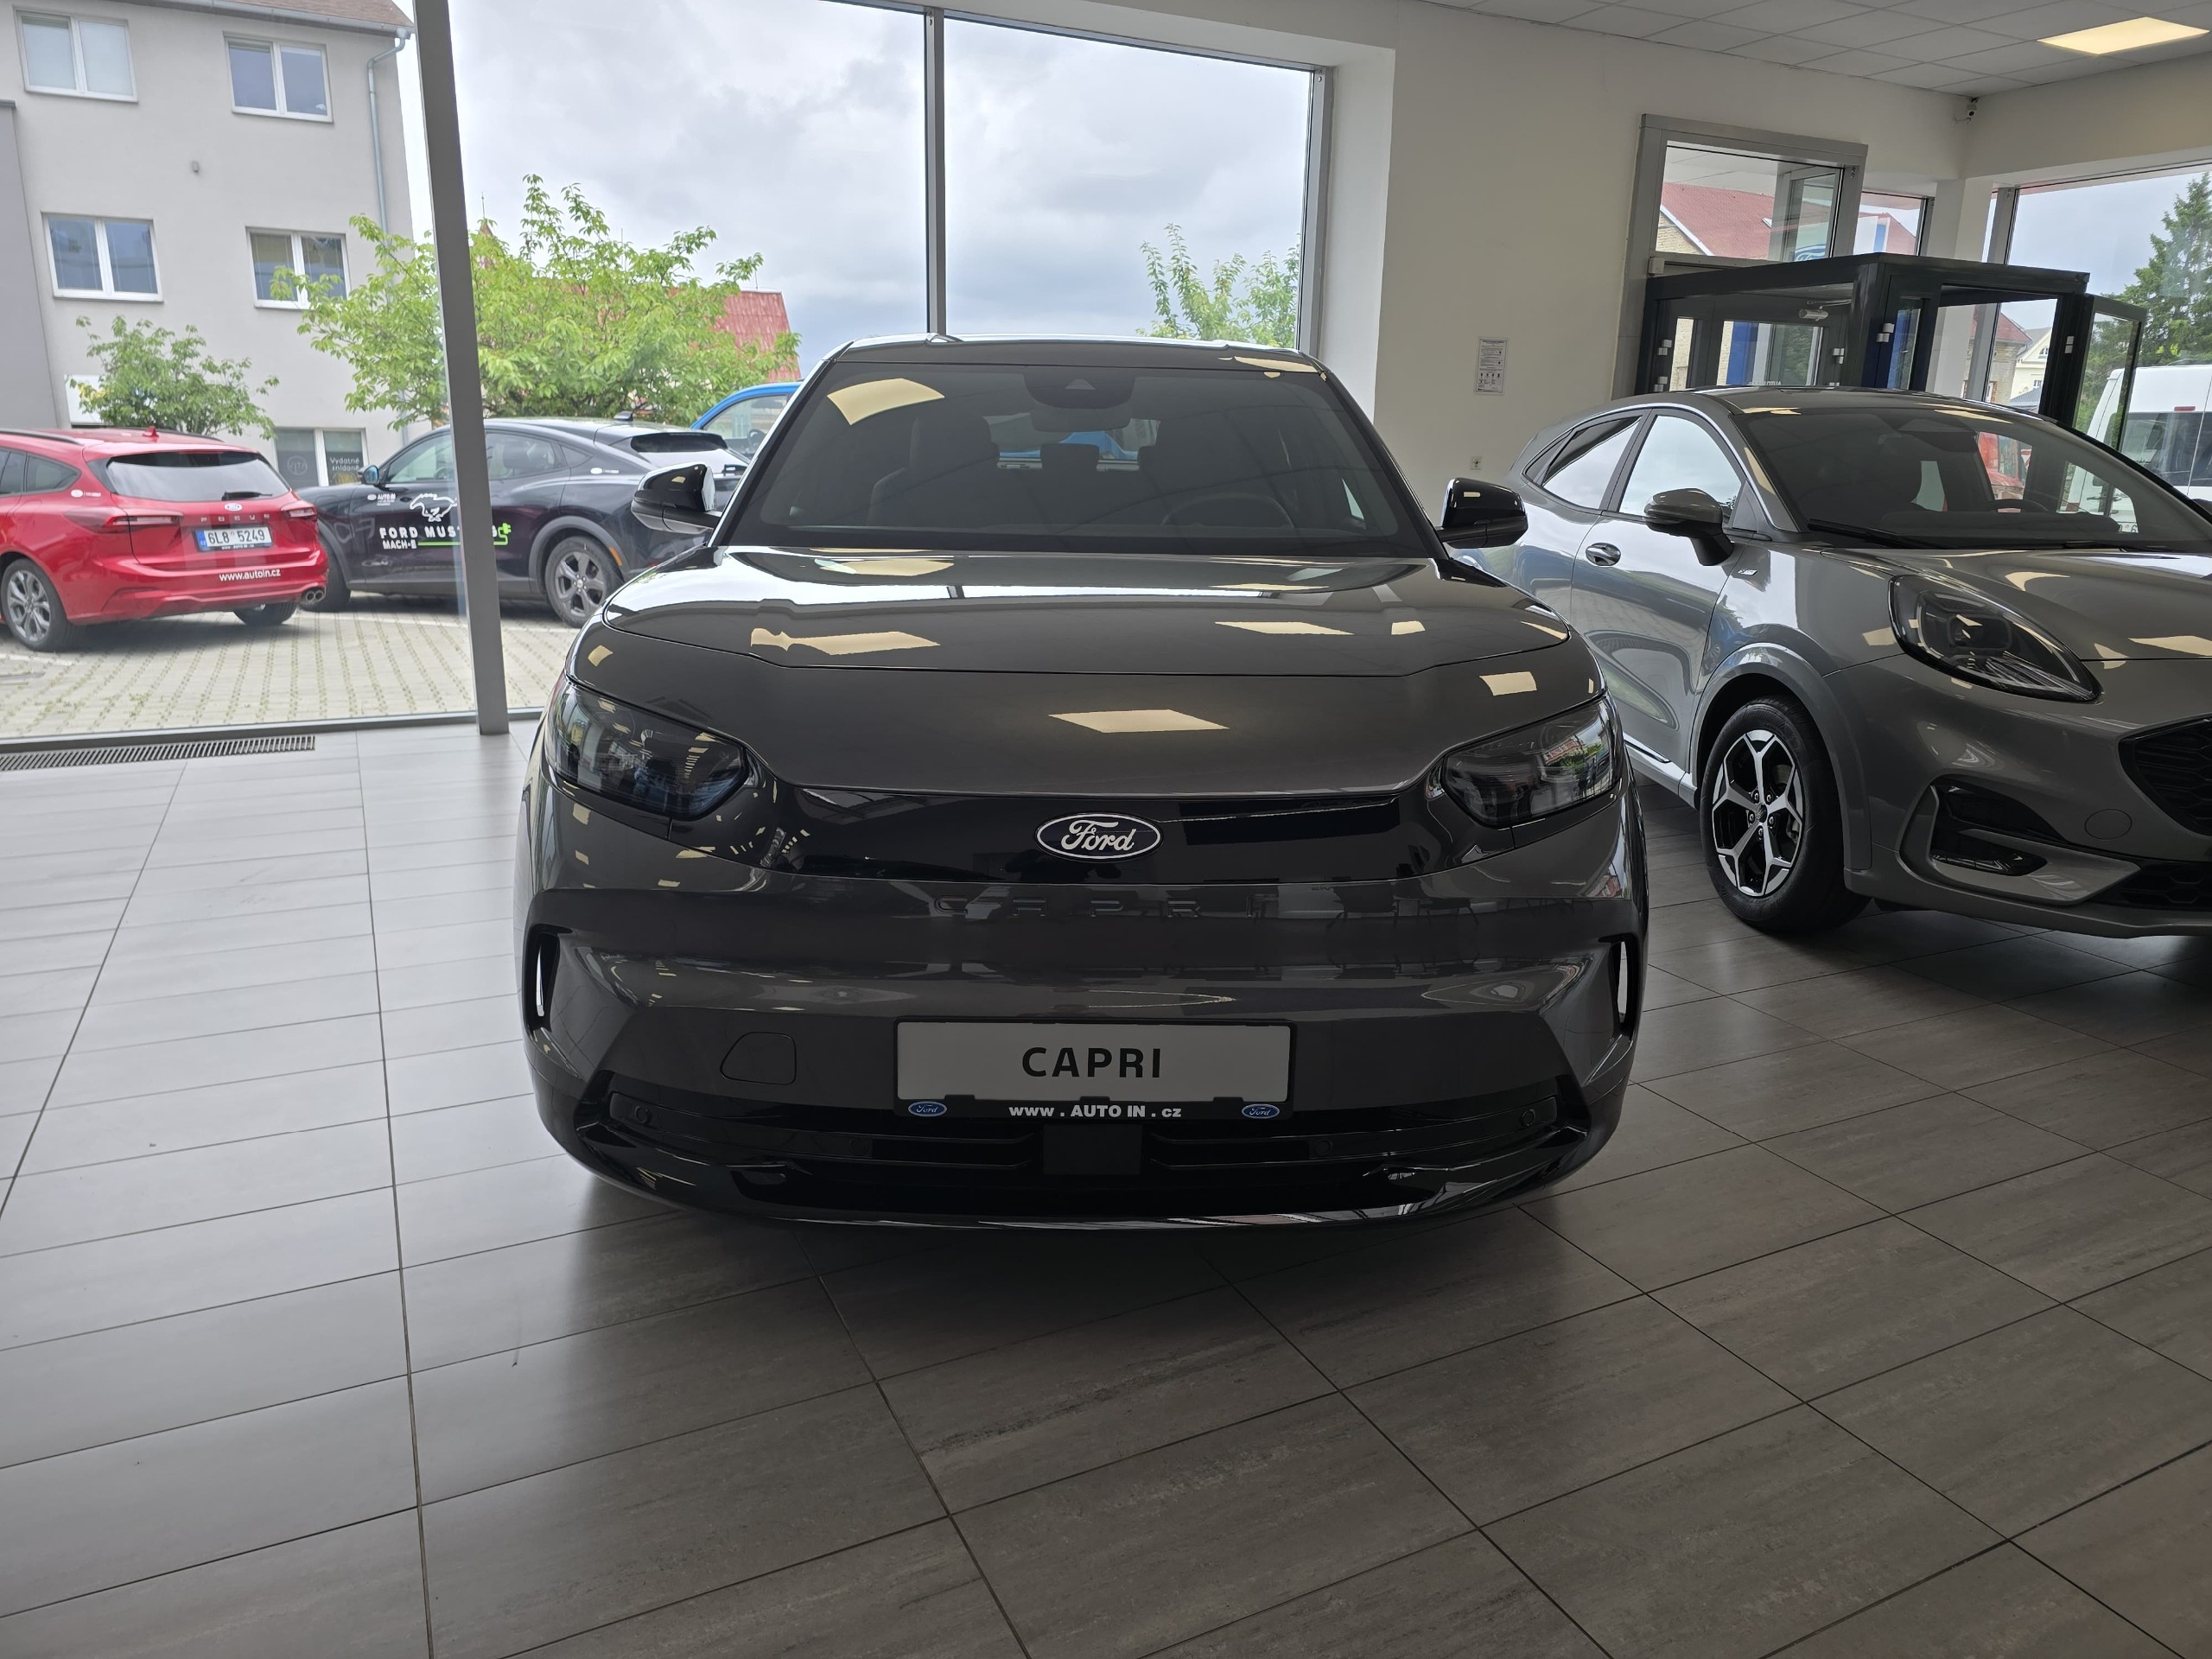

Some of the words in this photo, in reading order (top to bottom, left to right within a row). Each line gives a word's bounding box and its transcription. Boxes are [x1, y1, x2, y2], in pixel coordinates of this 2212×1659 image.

[208, 531, 230, 544] 6L8
[237, 529, 265, 543] 5249
[379, 527, 418, 539] FORD
[383, 539, 416, 550] MACH-E
[219, 569, 281, 582] www.autoin.cz
[1061, 820, 1137, 851] Ford
[1022, 1047, 1160, 1078] CAPRI
[1071, 1104, 1122, 1117] AUTO
[1127, 1105, 1146, 1117] IN
